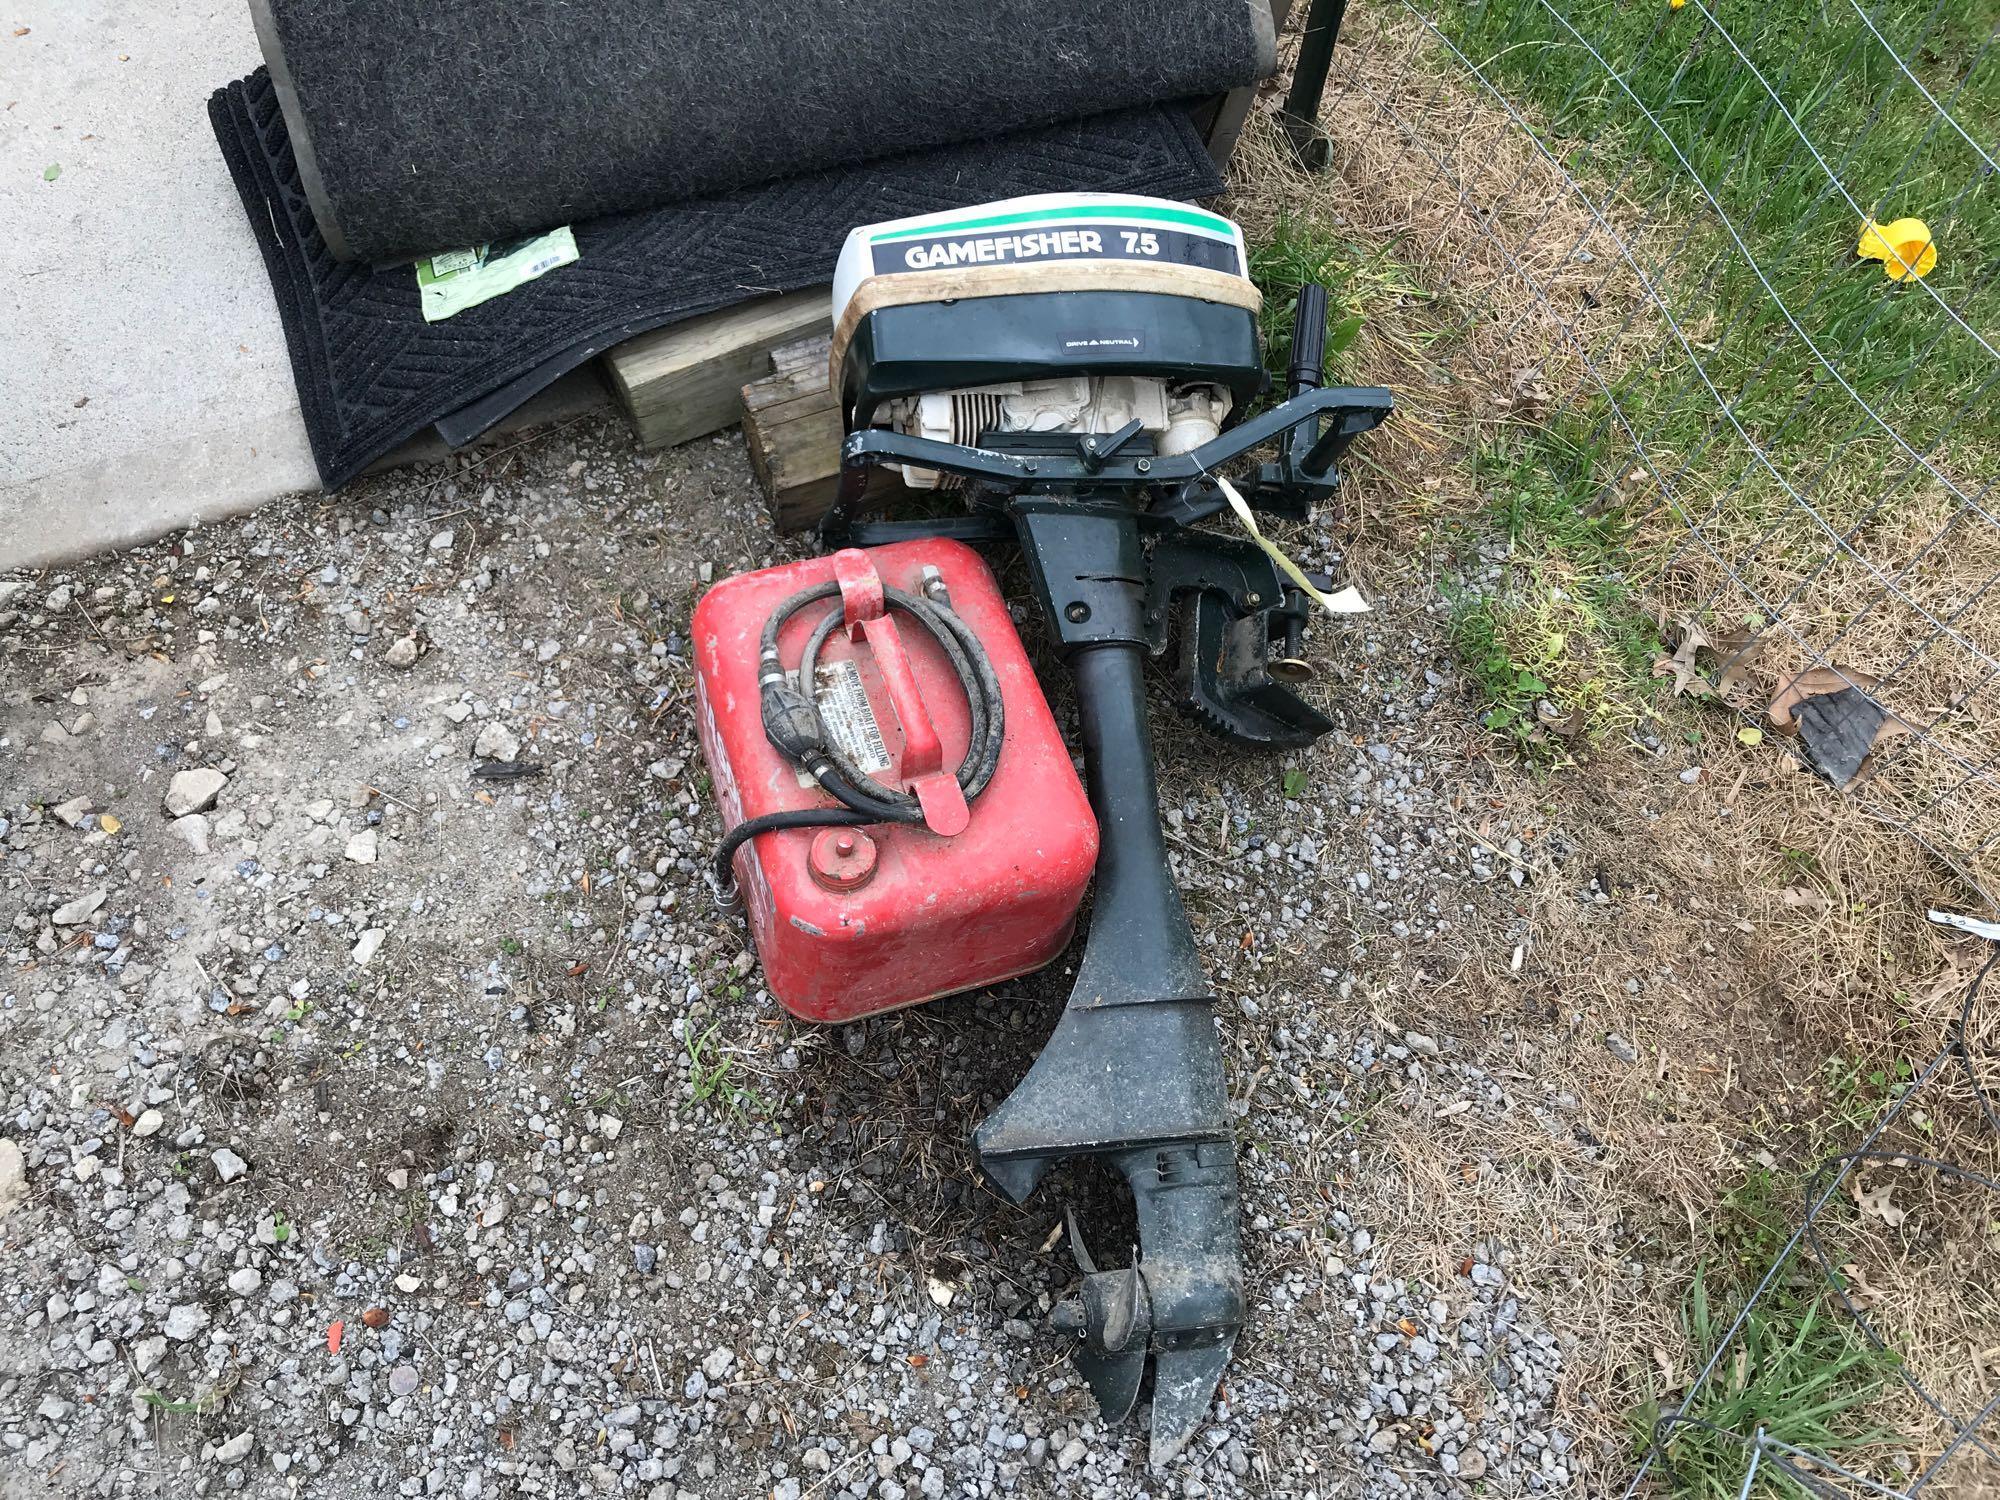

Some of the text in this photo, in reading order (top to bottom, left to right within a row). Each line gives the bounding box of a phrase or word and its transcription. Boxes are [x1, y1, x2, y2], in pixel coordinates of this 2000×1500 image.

[904, 230, 1160, 269] GAMEFISHER 7.5
[1065, 340, 1089, 348] DRIVE
[844, 661, 861, 688] REMOVE
[854, 688, 868, 708] FROM
[855, 711, 864, 727] FIRE
[861, 708, 875, 725] BOAT
[867, 726, 880, 740] FOR
[872, 741, 889, 767] FILLING
